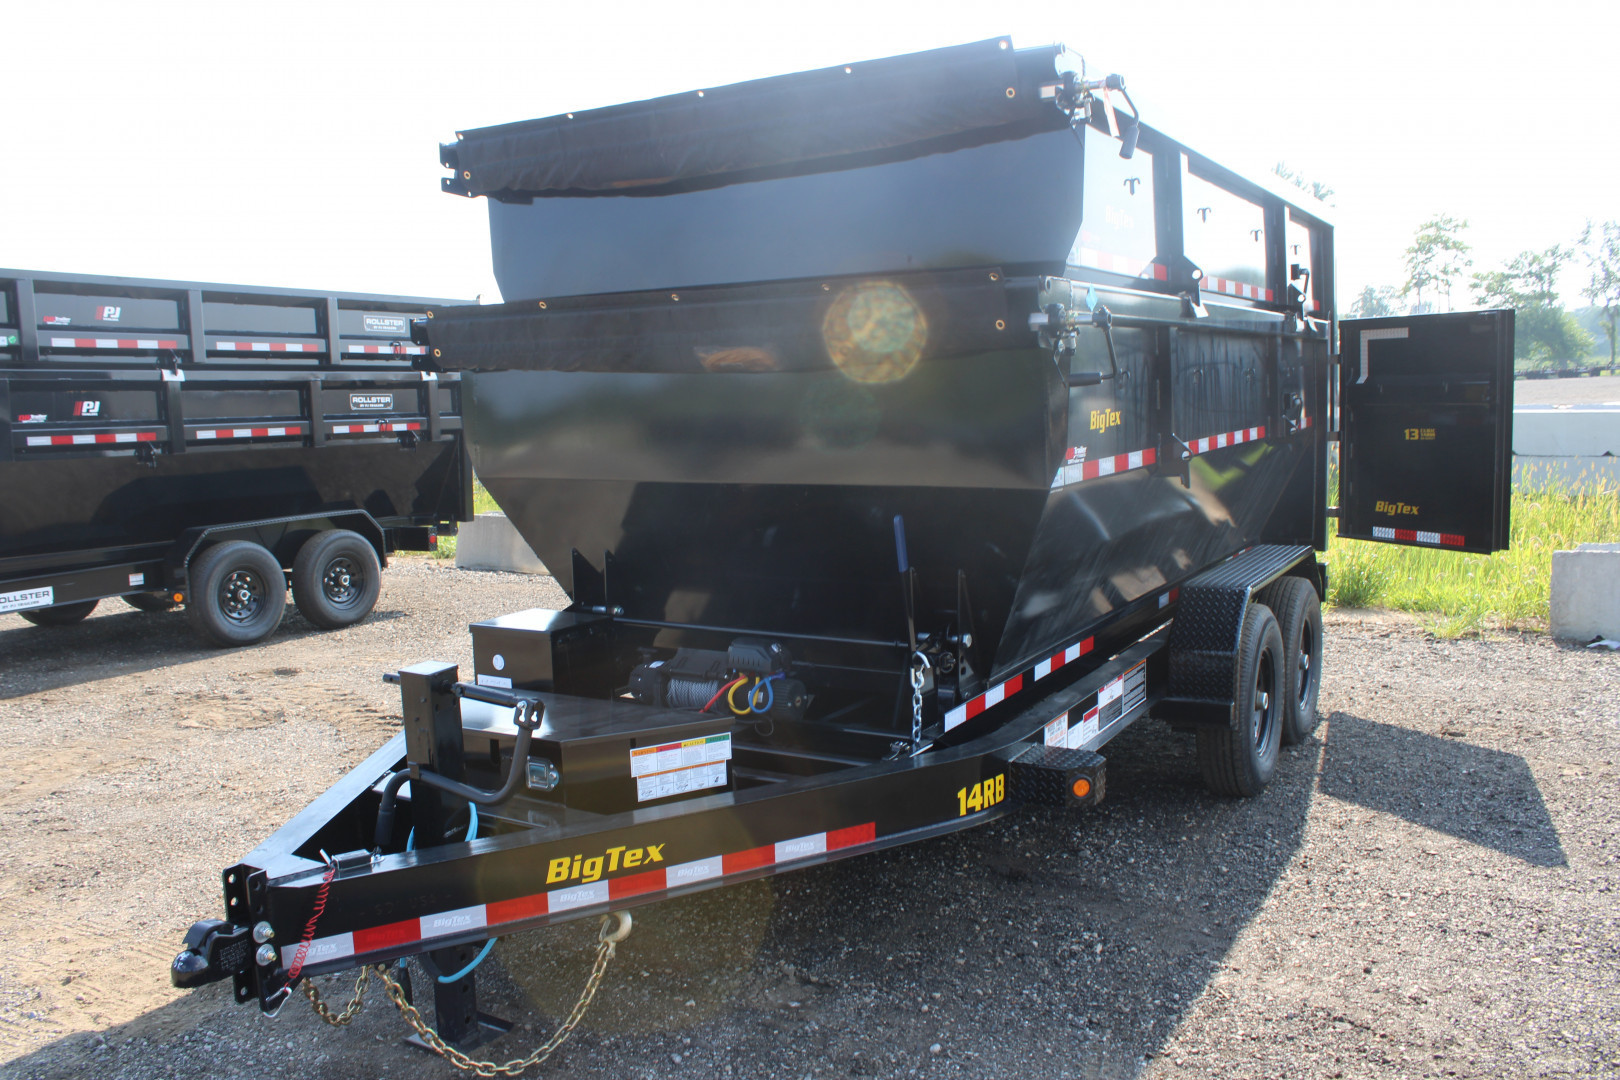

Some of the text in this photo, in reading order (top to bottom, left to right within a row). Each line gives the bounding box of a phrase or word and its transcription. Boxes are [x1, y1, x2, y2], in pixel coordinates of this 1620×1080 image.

[103, 306, 121, 318] PJ
[366, 318, 403, 326] ROLLSTER
[82, 401, 100, 412] PJ
[1090, 408, 1121, 433] BigTex
[1404, 428, 1419, 440] 13
[1375, 501, 1419, 515] BigTex
[0, 590, 50, 603] OLLSTER
[957, 773, 1005, 816] 14RB
[546, 843, 665, 884] BigTex
[560, 889, 595, 903] BigTex
[432, 913, 471, 928] BigTex
